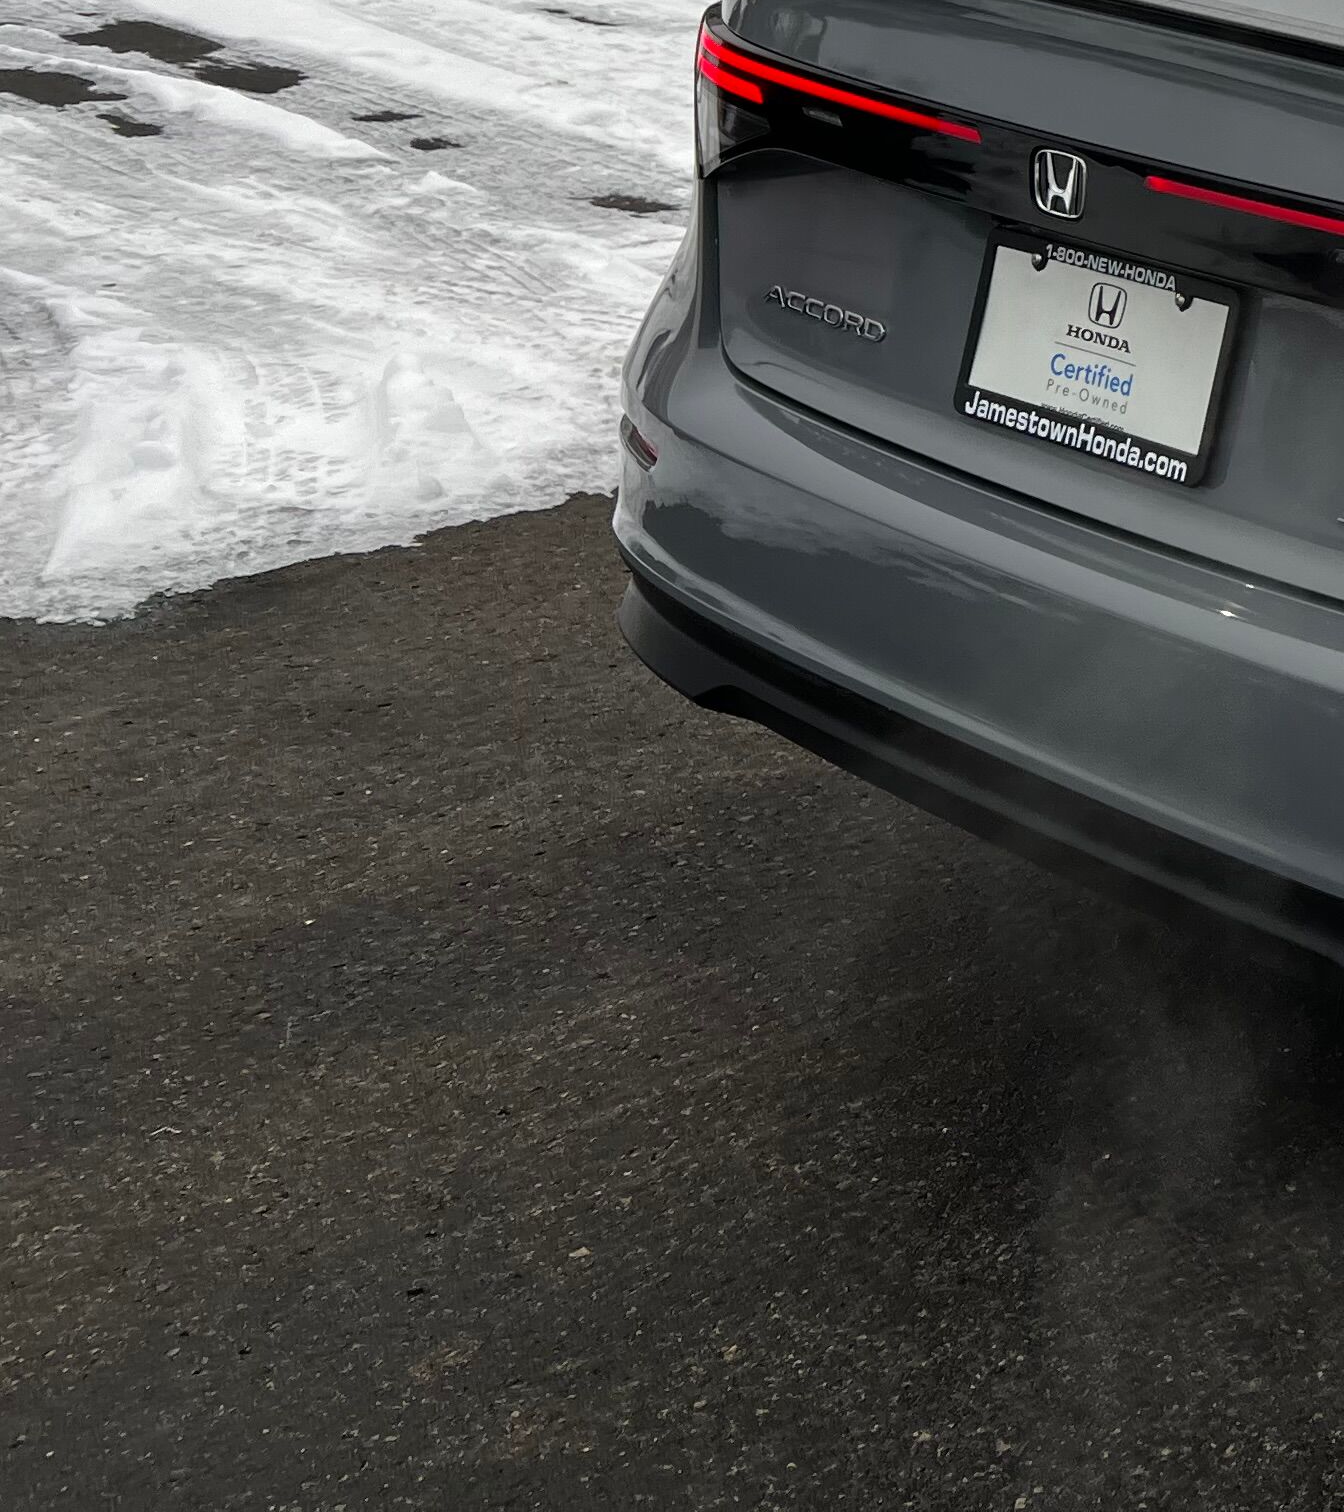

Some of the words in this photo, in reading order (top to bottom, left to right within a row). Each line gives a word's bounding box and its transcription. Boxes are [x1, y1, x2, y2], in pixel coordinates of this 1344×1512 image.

[1045, 243, 1177, 292] 1-800-NEW-HONDA
[763, 284, 887, 343] ACCORD
[1065, 324, 1132, 354] HONDA
[1045, 378, 1129, 415] Pre-Owned
[1050, 352, 1134, 397] Certified
[964, 390, 1188, 482] JamestownHonda.com
